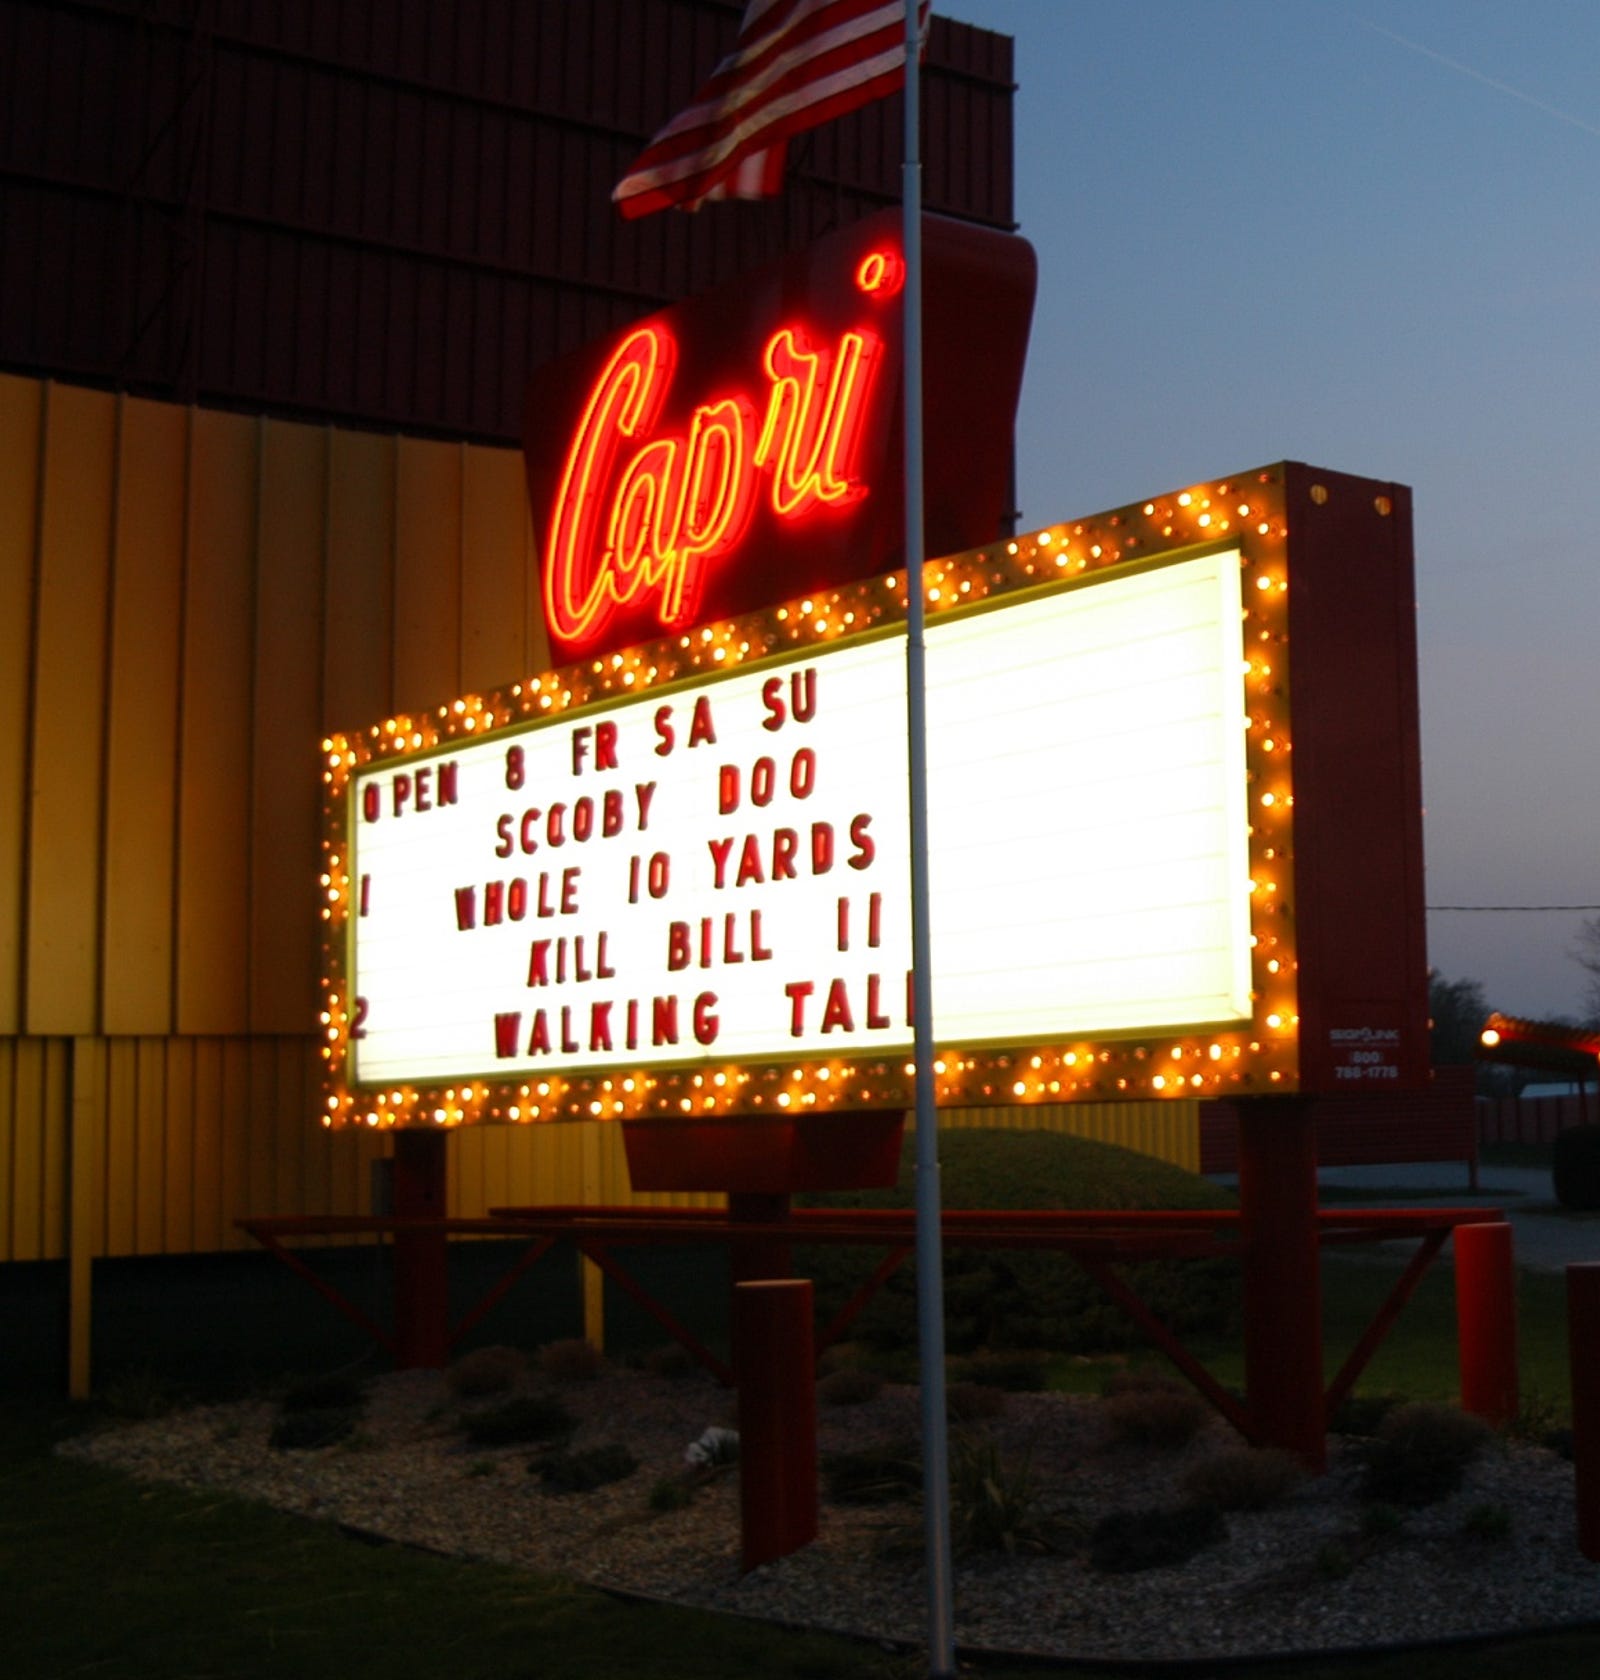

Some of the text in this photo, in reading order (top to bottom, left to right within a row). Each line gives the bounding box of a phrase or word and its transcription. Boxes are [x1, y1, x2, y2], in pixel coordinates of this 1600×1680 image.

[546, 245, 904, 640] Capri
[362, 668, 817, 824] OPEN 8 FR SA SU
[718, 747, 816, 816] DOO
[454, 813, 875, 932] WHOLE 10 YARDS
[526, 931, 615, 988] KILL
[667, 909, 772, 972] BILL
[349, 995, 369, 1041] 2
[494, 991, 719, 1059] WALKING
